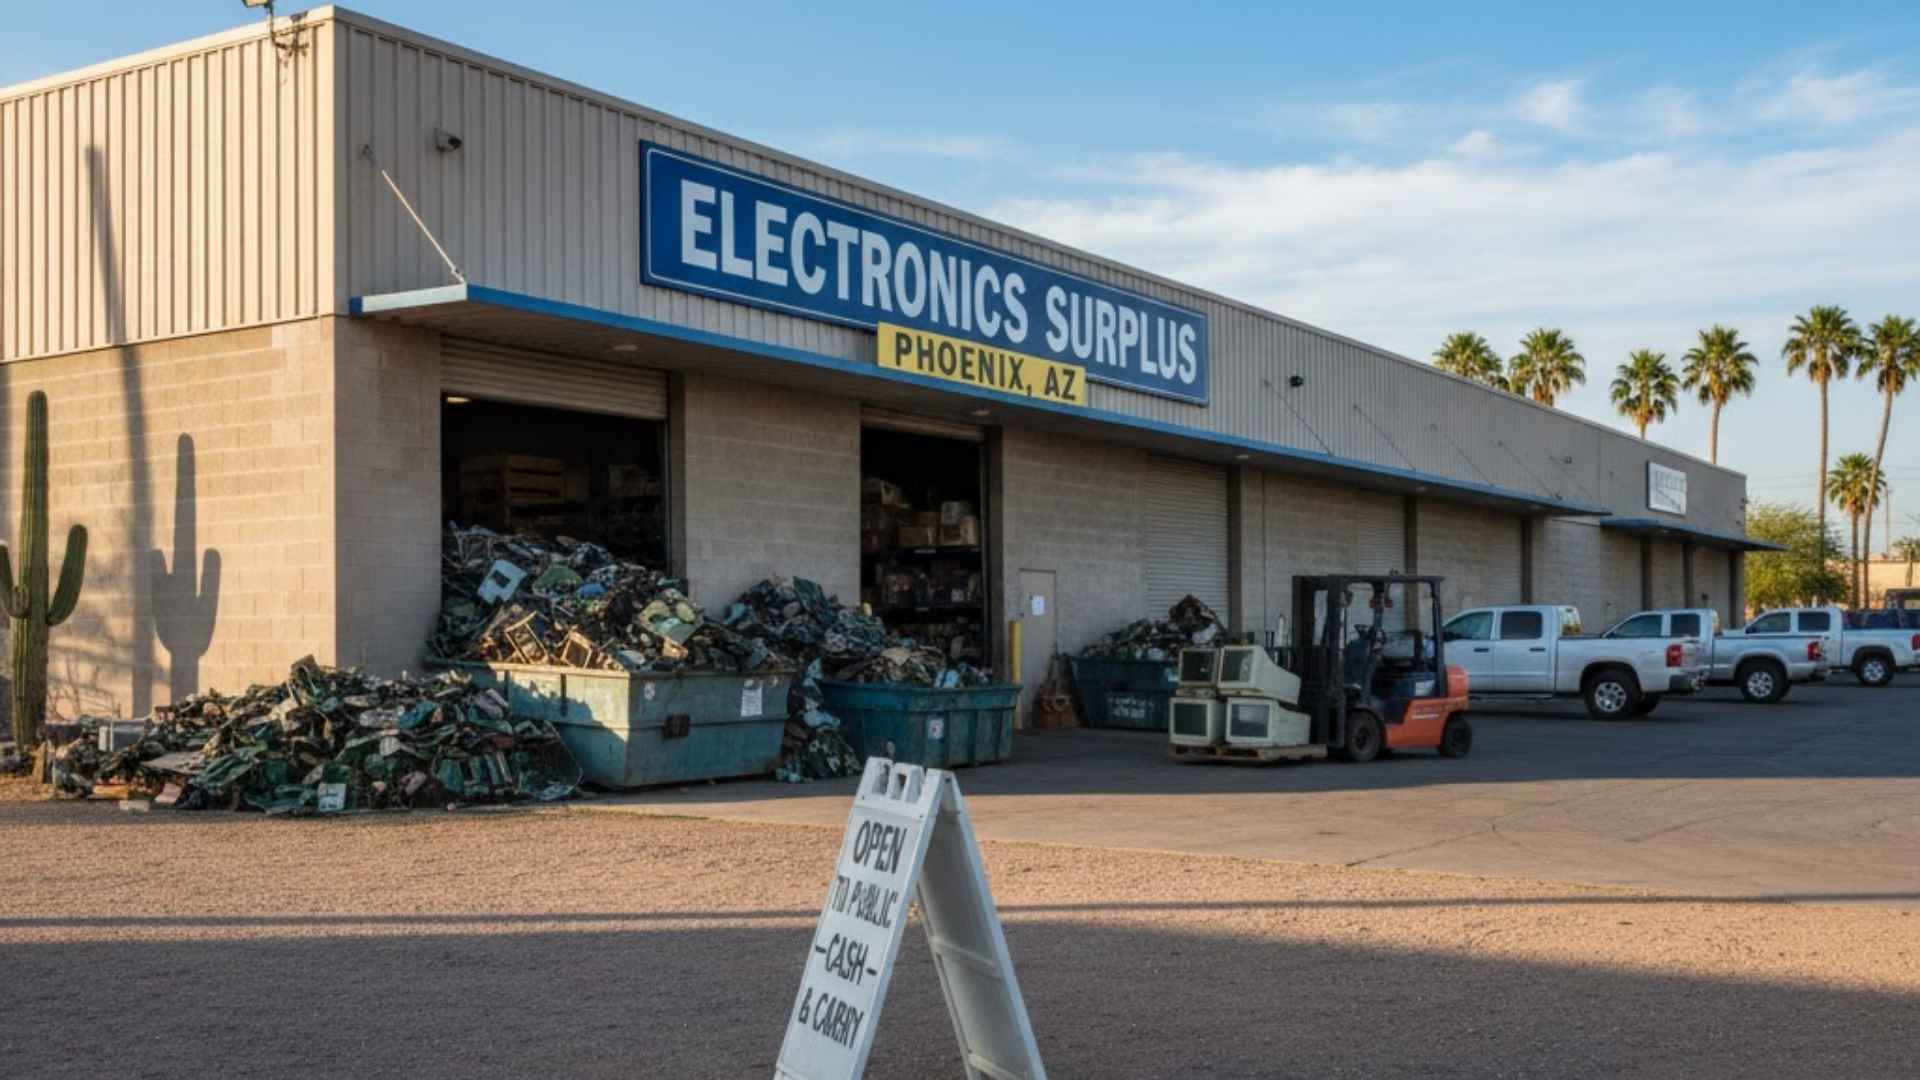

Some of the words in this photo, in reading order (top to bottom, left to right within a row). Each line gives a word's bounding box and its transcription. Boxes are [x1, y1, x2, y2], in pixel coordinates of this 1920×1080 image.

[680, 178, 1028, 344] ELECTRONICS
[1045, 284, 1197, 385] SURPLUS
[894, 332, 1032, 395] PHOENIX,
[1043, 365, 1077, 401] AZ
[853, 820, 906, 874] OPEN
[832, 875, 850, 912] TO
[847, 880, 898, 928] PUBLIC
[813, 993, 864, 1050] CARRY
